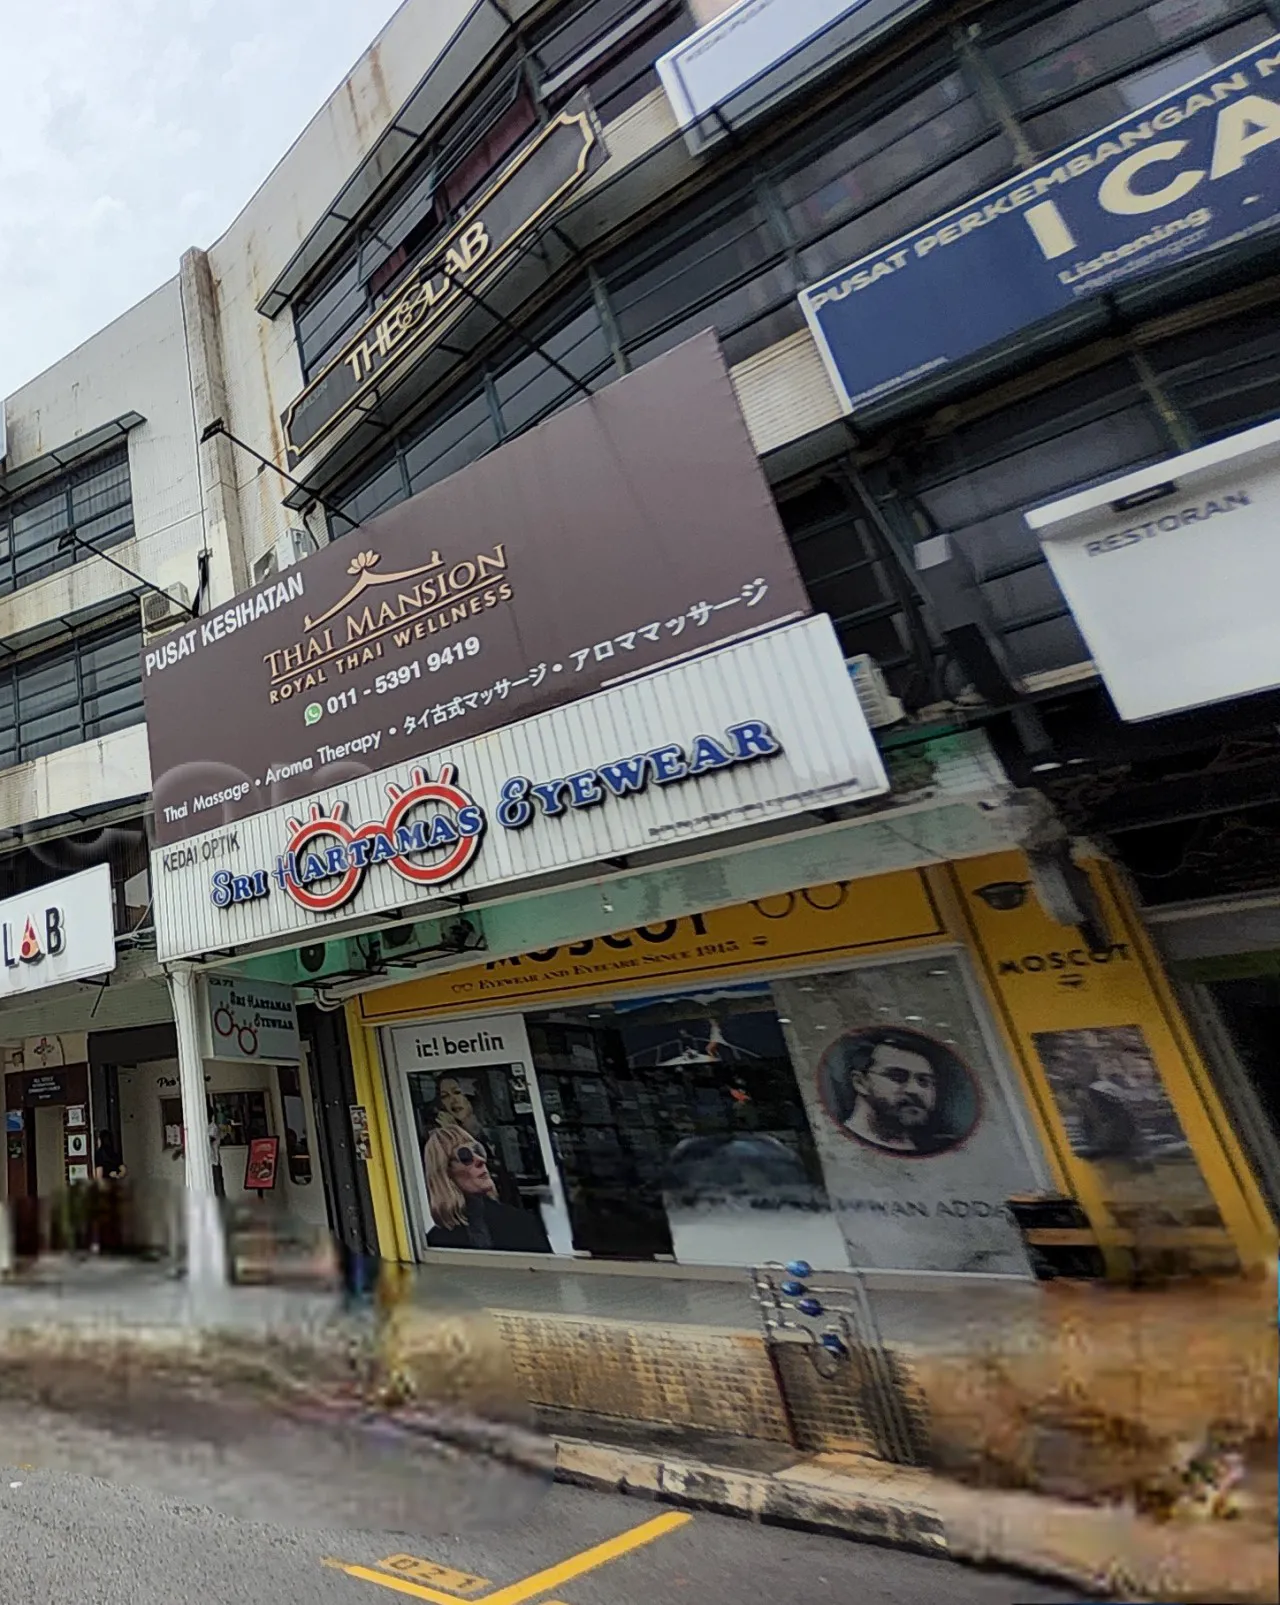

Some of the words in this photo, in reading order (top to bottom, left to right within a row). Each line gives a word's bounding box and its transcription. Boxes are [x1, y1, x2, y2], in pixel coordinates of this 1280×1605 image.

[809, 248, 909, 312] PUSAT
[914, 72, 1249, 258] PERKEMBANGAN
[1023, 199, 1077, 260] I
[1058, 207, 1212, 284] Listening
[345, 303, 407, 382] THE
[1084, 489, 1252, 557] RESTORAN
[145, 633, 197, 676] PUSAT
[201, 572, 304, 648] KESIHATAN
[263, 630, 333, 678] THAI
[346, 544, 508, 642] MANSION
[269, 669, 328, 704] ROYAL
[336, 643, 384, 675] THAI
[393, 584, 514, 649] WELLNESS
[327, 687, 357, 714] 011
[375, 661, 422, 695] 5391
[427, 635, 481, 672] 9419
[403, 663, 547, 735] タイ古式マッサージ
[569, 577, 769, 673] アロママッサージ
[163, 803, 188, 823] Thai
[193, 779, 250, 816] Massage
[265, 756, 313, 786] Aroma
[317, 730, 382, 766] Therapy
[210, 867, 269, 908] SRI
[496, 719, 782, 829] EYEWEAR
[162, 844, 199, 873] KEDAI
[201, 830, 240, 861] OPTIK
[443, 1032, 504, 1055] berlin
